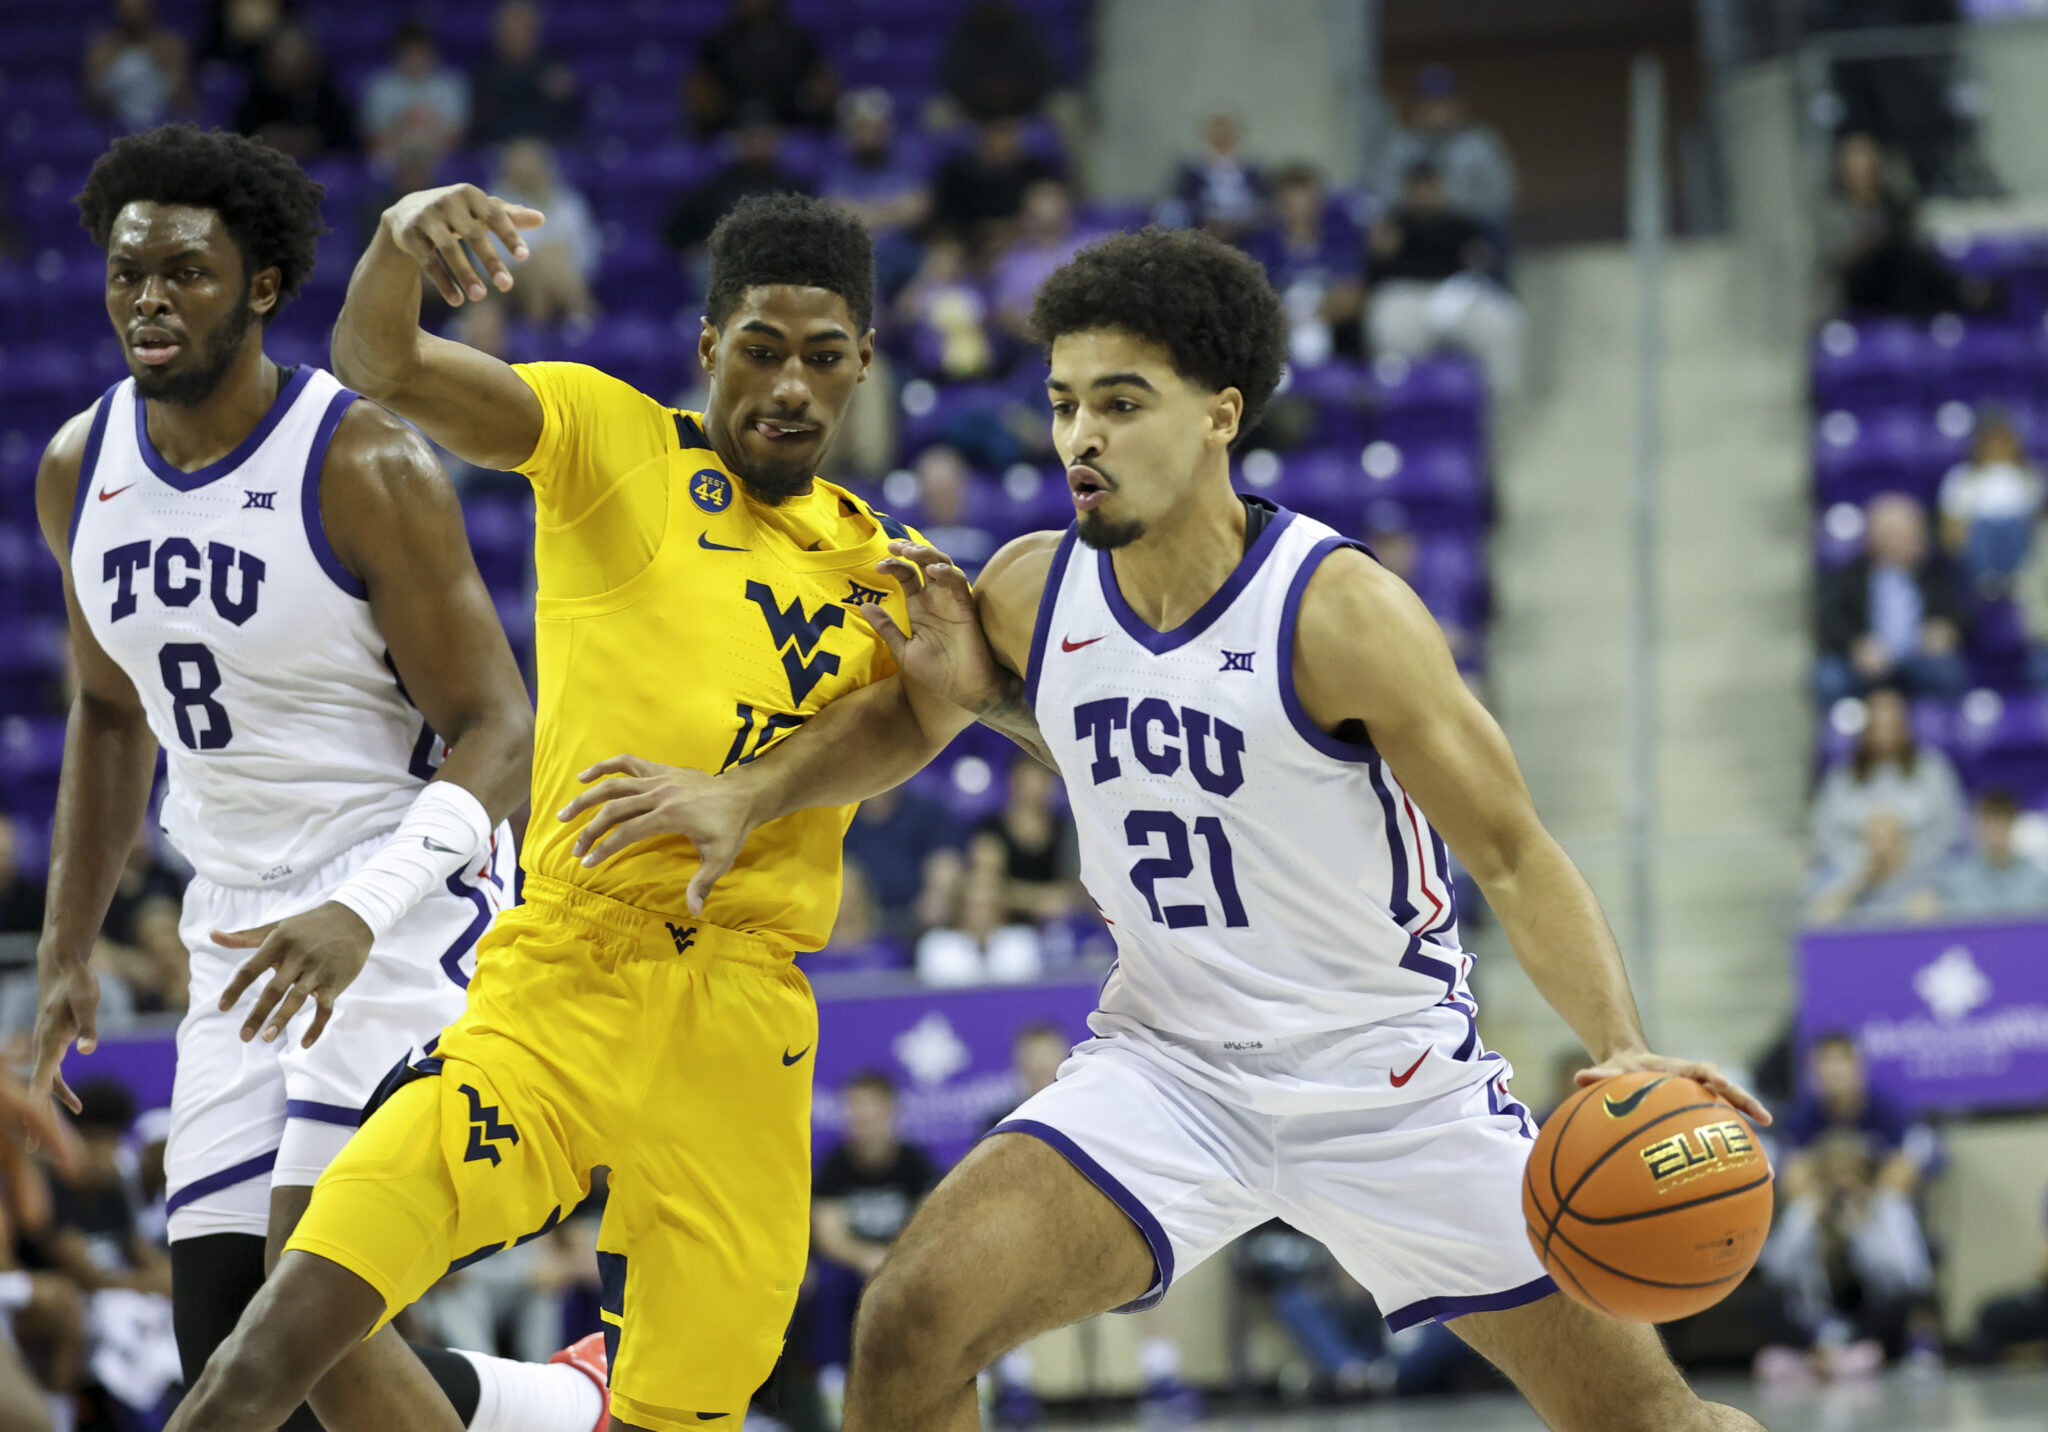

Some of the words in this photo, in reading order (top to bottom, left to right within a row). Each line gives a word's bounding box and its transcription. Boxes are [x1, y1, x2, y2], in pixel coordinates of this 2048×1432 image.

[242, 489, 278, 511] XII
[694, 482, 724, 507] 44
[700, 474, 726, 489] WEST
[103, 537, 266, 627] TCU
[1218, 649, 1256, 673] XII
[158, 642, 233, 749] 8
[1073, 696, 1246, 798] TCU
[1123, 810, 1249, 930] 21
[1641, 1121, 1754, 1181] ELITE
